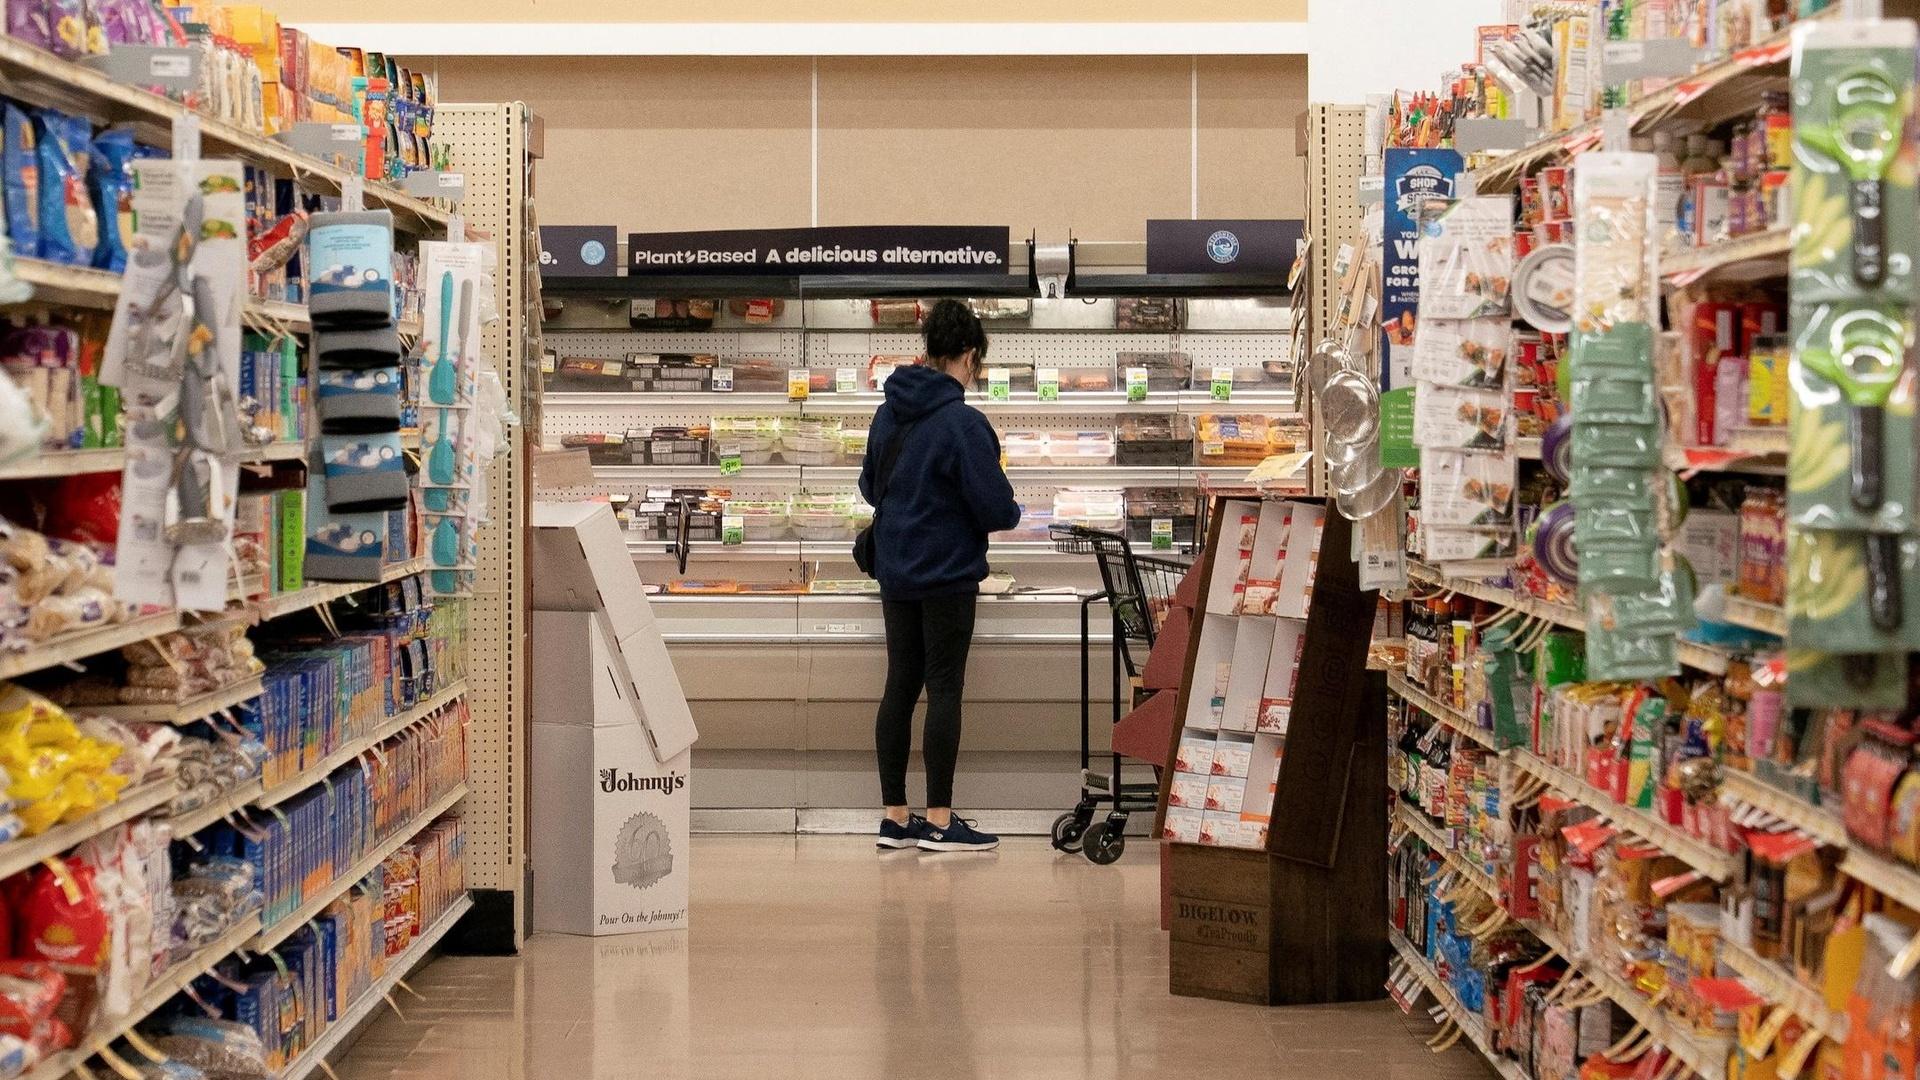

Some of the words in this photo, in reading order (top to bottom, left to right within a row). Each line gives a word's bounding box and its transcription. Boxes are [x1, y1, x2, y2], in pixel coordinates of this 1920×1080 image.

[1409, 178, 1438, 189] SHOP
[1400, 231, 1419, 239] YOU
[635, 250, 684, 264] Plant
[697, 249, 756, 263] Based
[765, 249, 781, 263] A
[786, 245, 877, 264] delicious
[882, 246, 1002, 264] alternative.
[1386, 277, 1410, 287] FOR
[600, 768, 685, 796] Johnny's
[600, 914, 619, 925] Pour
[621, 912, 634, 924] On
[636, 912, 648, 922] the
[1179, 903, 1258, 926] BIGELOW
